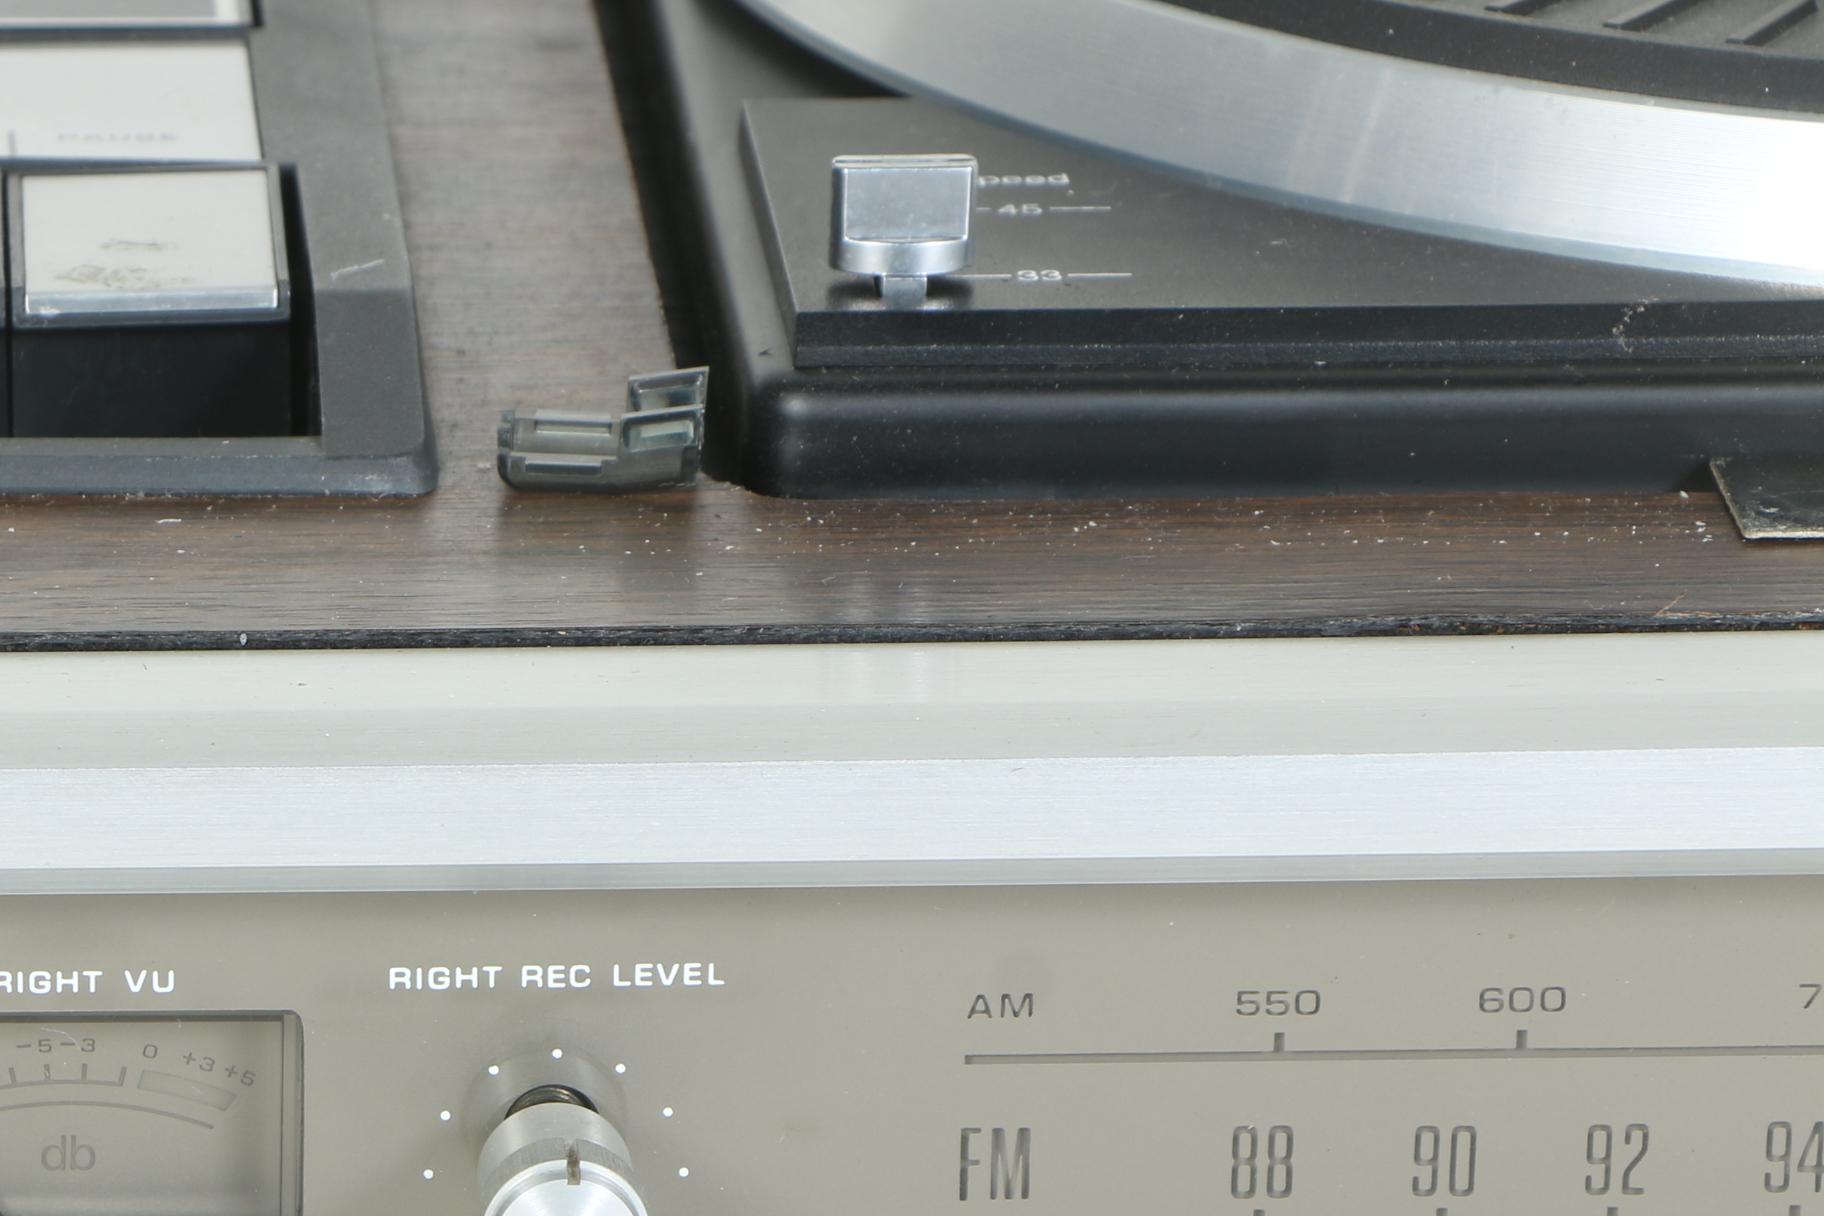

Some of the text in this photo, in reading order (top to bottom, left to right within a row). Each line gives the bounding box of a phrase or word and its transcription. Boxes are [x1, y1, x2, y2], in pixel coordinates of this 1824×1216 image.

[977, 173, 1070, 189] peed
[998, 203, 1043, 216] 45
[1016, 270, 1063, 281] 33
[124, 969, 175, 993] VU
[389, 962, 725, 990] RIGHT REC LEVEL
[967, 992, 1034, 1020] AM
[1235, 989, 1321, 1016] 550
[1478, 986, 1567, 1013] 600
[142, 1044, 158, 1060] 0
[41, 1134, 96, 1172] db
[958, 1120, 1824, 1202] FM 88 90 92 94
